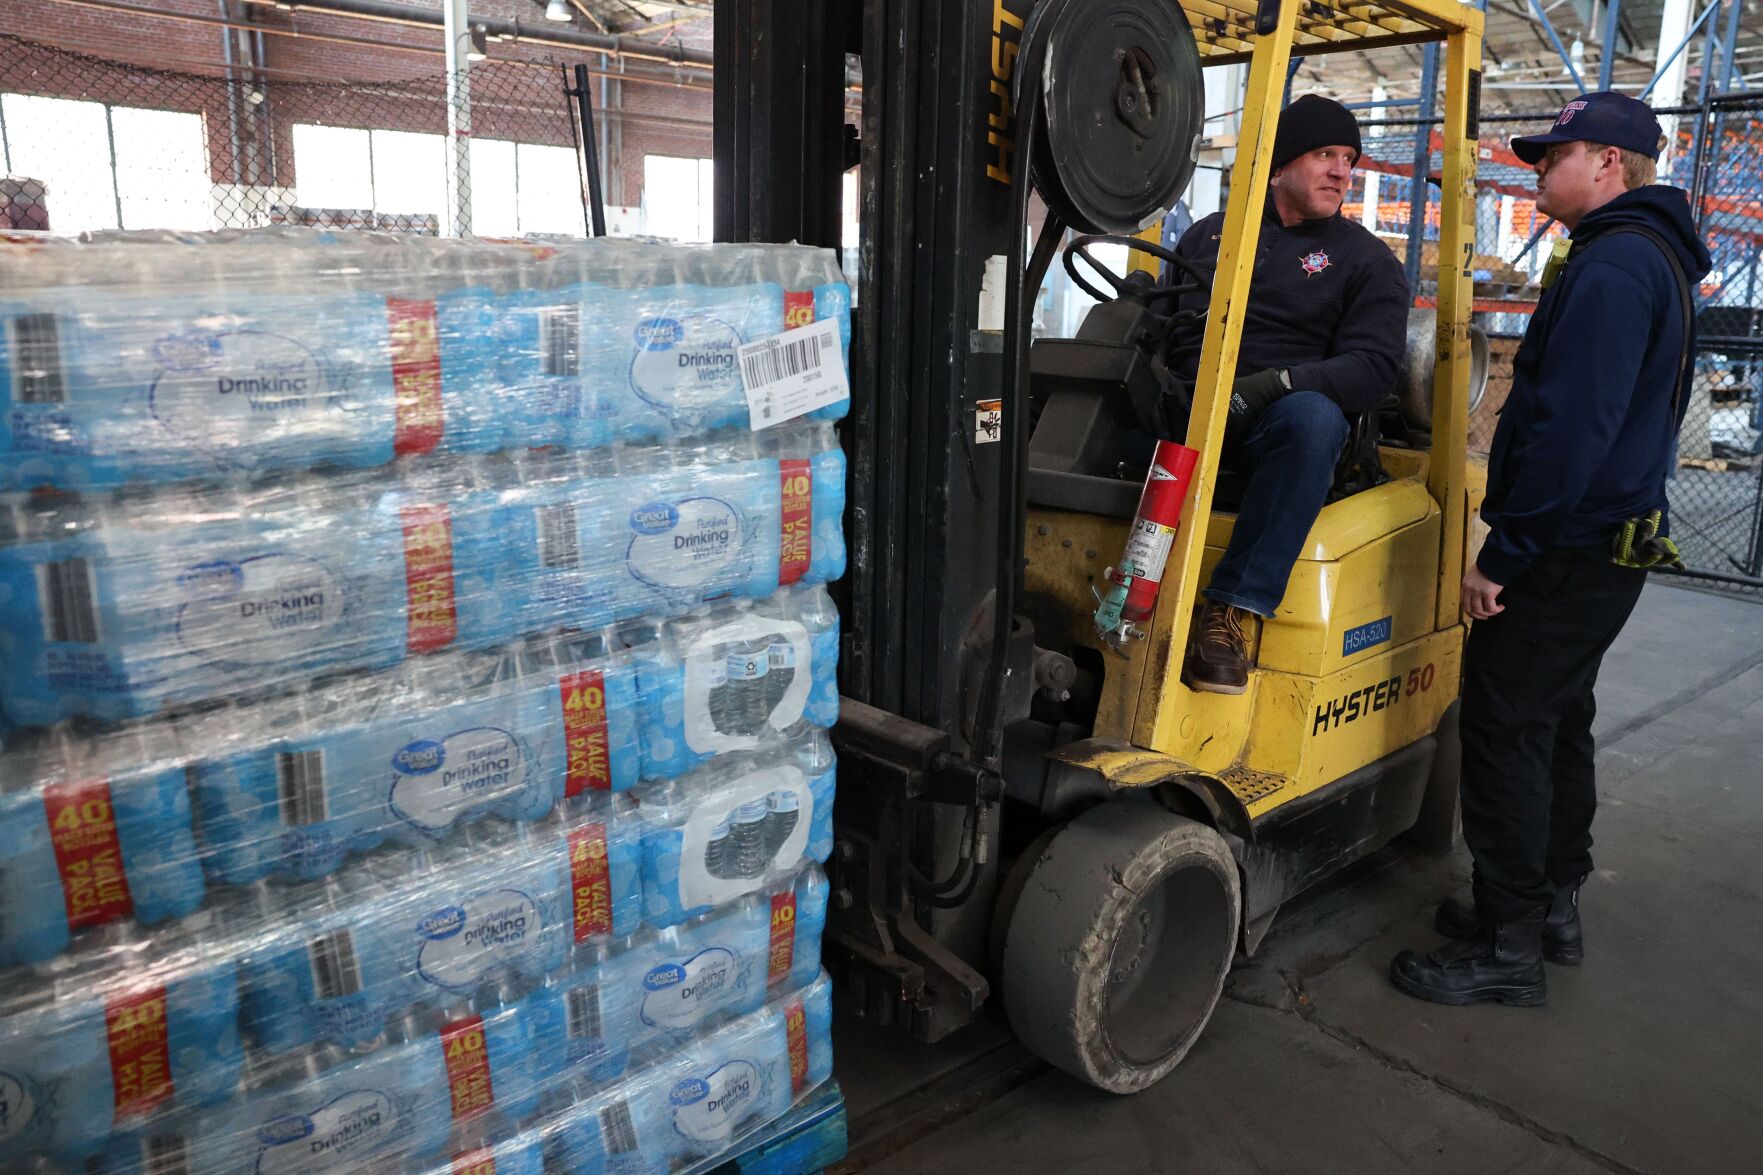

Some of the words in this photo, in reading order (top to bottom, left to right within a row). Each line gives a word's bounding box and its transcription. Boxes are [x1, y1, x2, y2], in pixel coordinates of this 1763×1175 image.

[785, 306, 814, 327] 40
[678, 352, 734, 369] Drinking
[217, 374, 308, 396] Drinking
[696, 366, 734, 382] Water
[782, 476, 809, 497] 40
[635, 508, 671, 523] Great
[674, 530, 728, 549] Drinking
[782, 521, 795, 565] PACK
[792, 516, 809, 561] VALUE
[240, 593, 324, 618] Drinking
[1345, 622, 1387, 651] HSA-520
[565, 686, 603, 711] 40
[1312, 675, 1402, 737] HYSTER
[1405, 662, 1436, 697] 50
[570, 737, 588, 779] PACK
[443, 758, 509, 786] Drinking
[55, 799, 109, 829] 40
[574, 839, 606, 862] 40
[771, 906, 794, 926] 40
[465, 917, 526, 946] Drinking
[647, 969, 679, 984] Great
[682, 969, 727, 999] Drinking
[448, 1031, 483, 1058] 40
[708, 1080, 750, 1112] Drinking
[311, 1112, 381, 1153] Drinking
